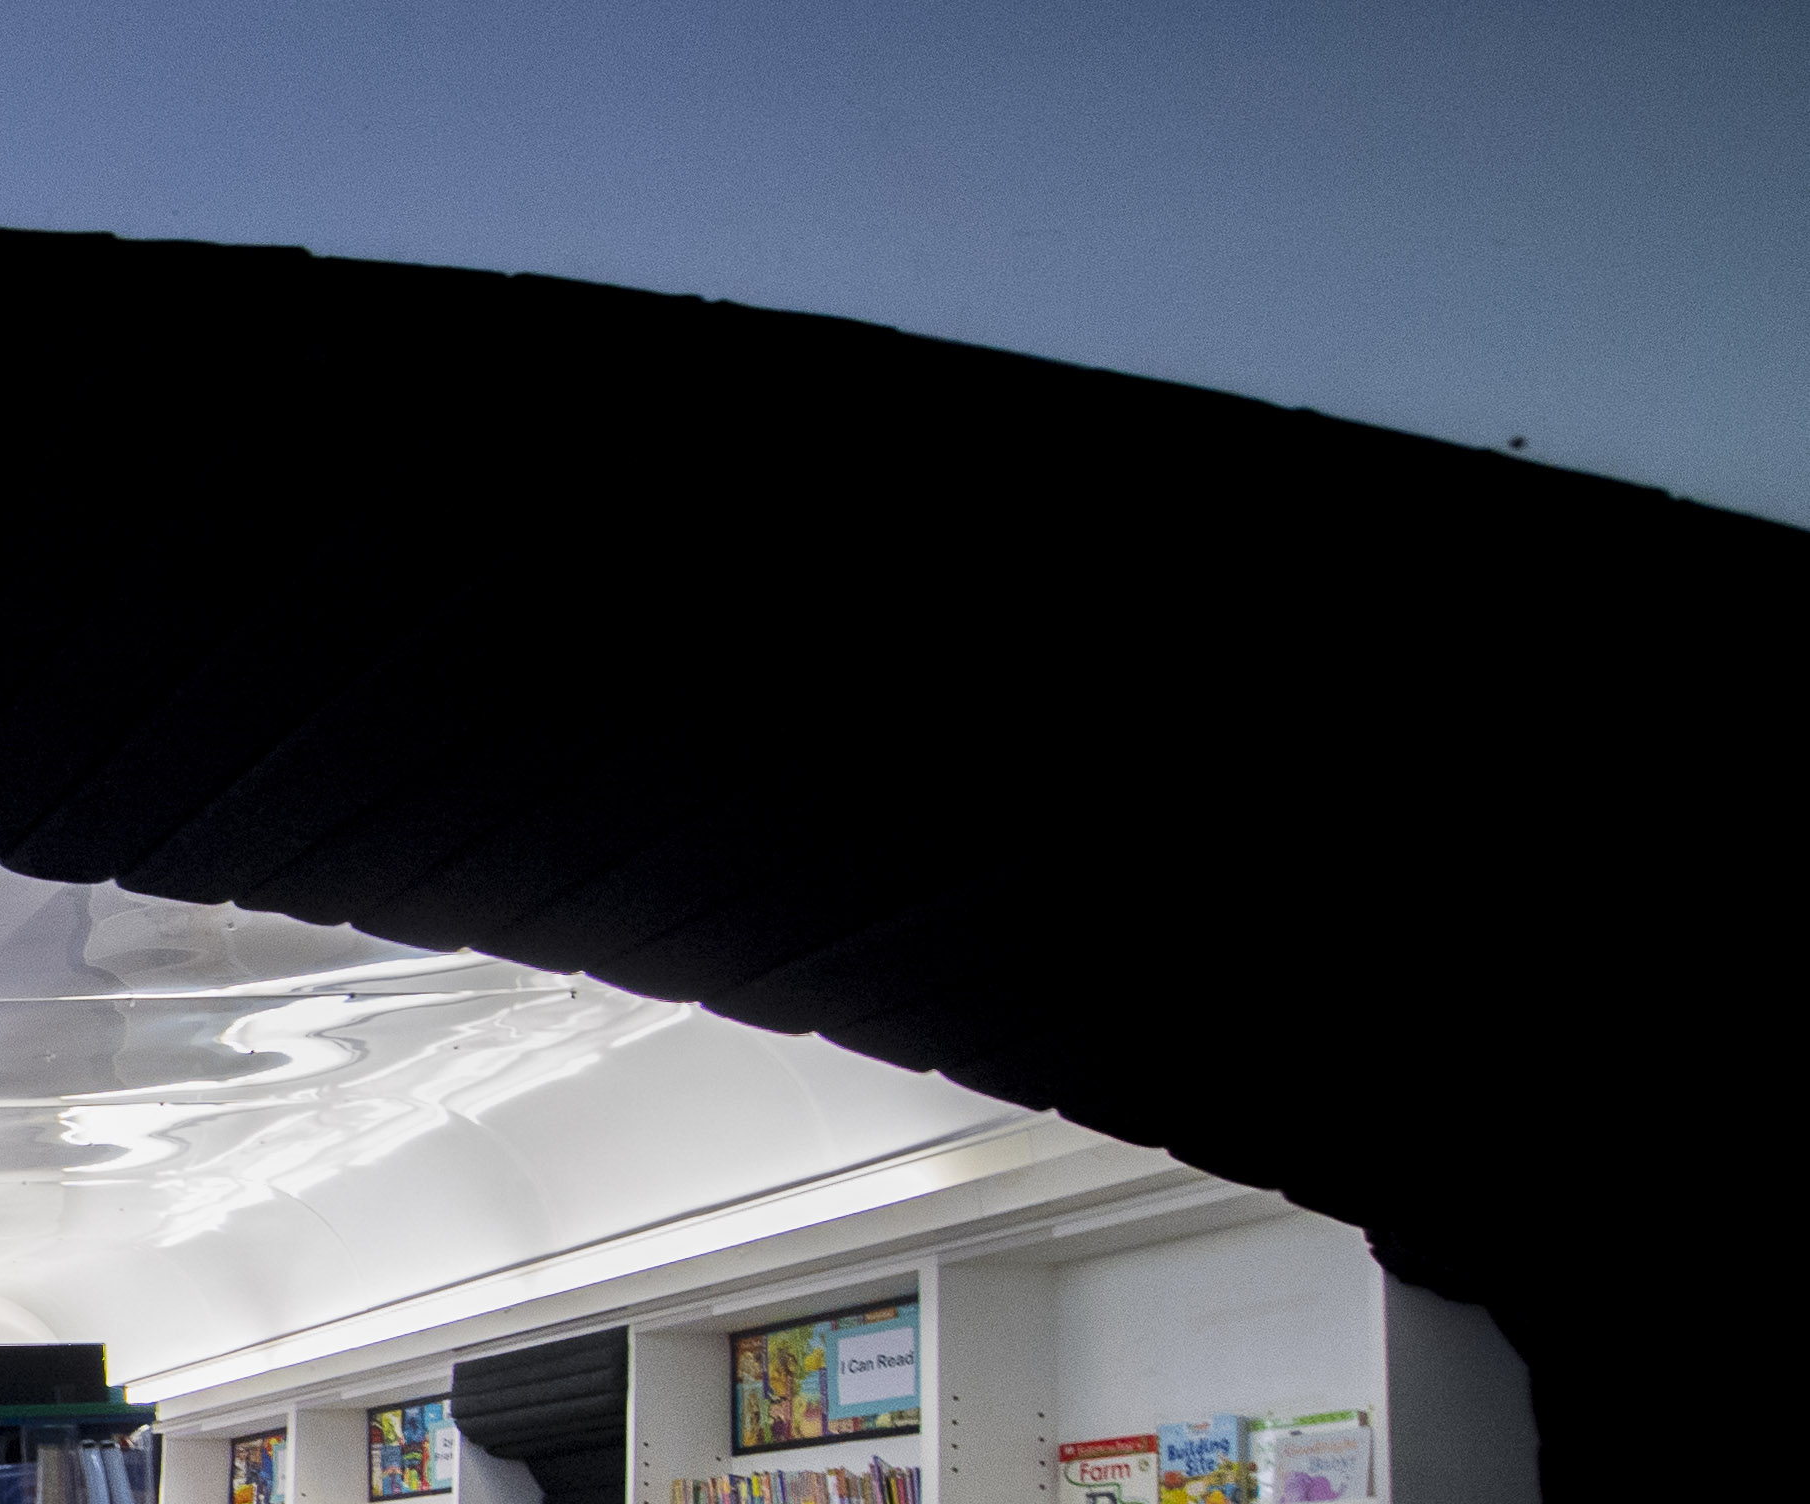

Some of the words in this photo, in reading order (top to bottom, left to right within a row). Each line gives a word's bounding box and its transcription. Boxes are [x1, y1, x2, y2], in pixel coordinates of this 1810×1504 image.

[848, 1357, 874, 1375] Can
[877, 1350, 915, 1369] Read
[1167, 1437, 1231, 1461] Building
[1079, 1461, 1132, 1483] Farm
